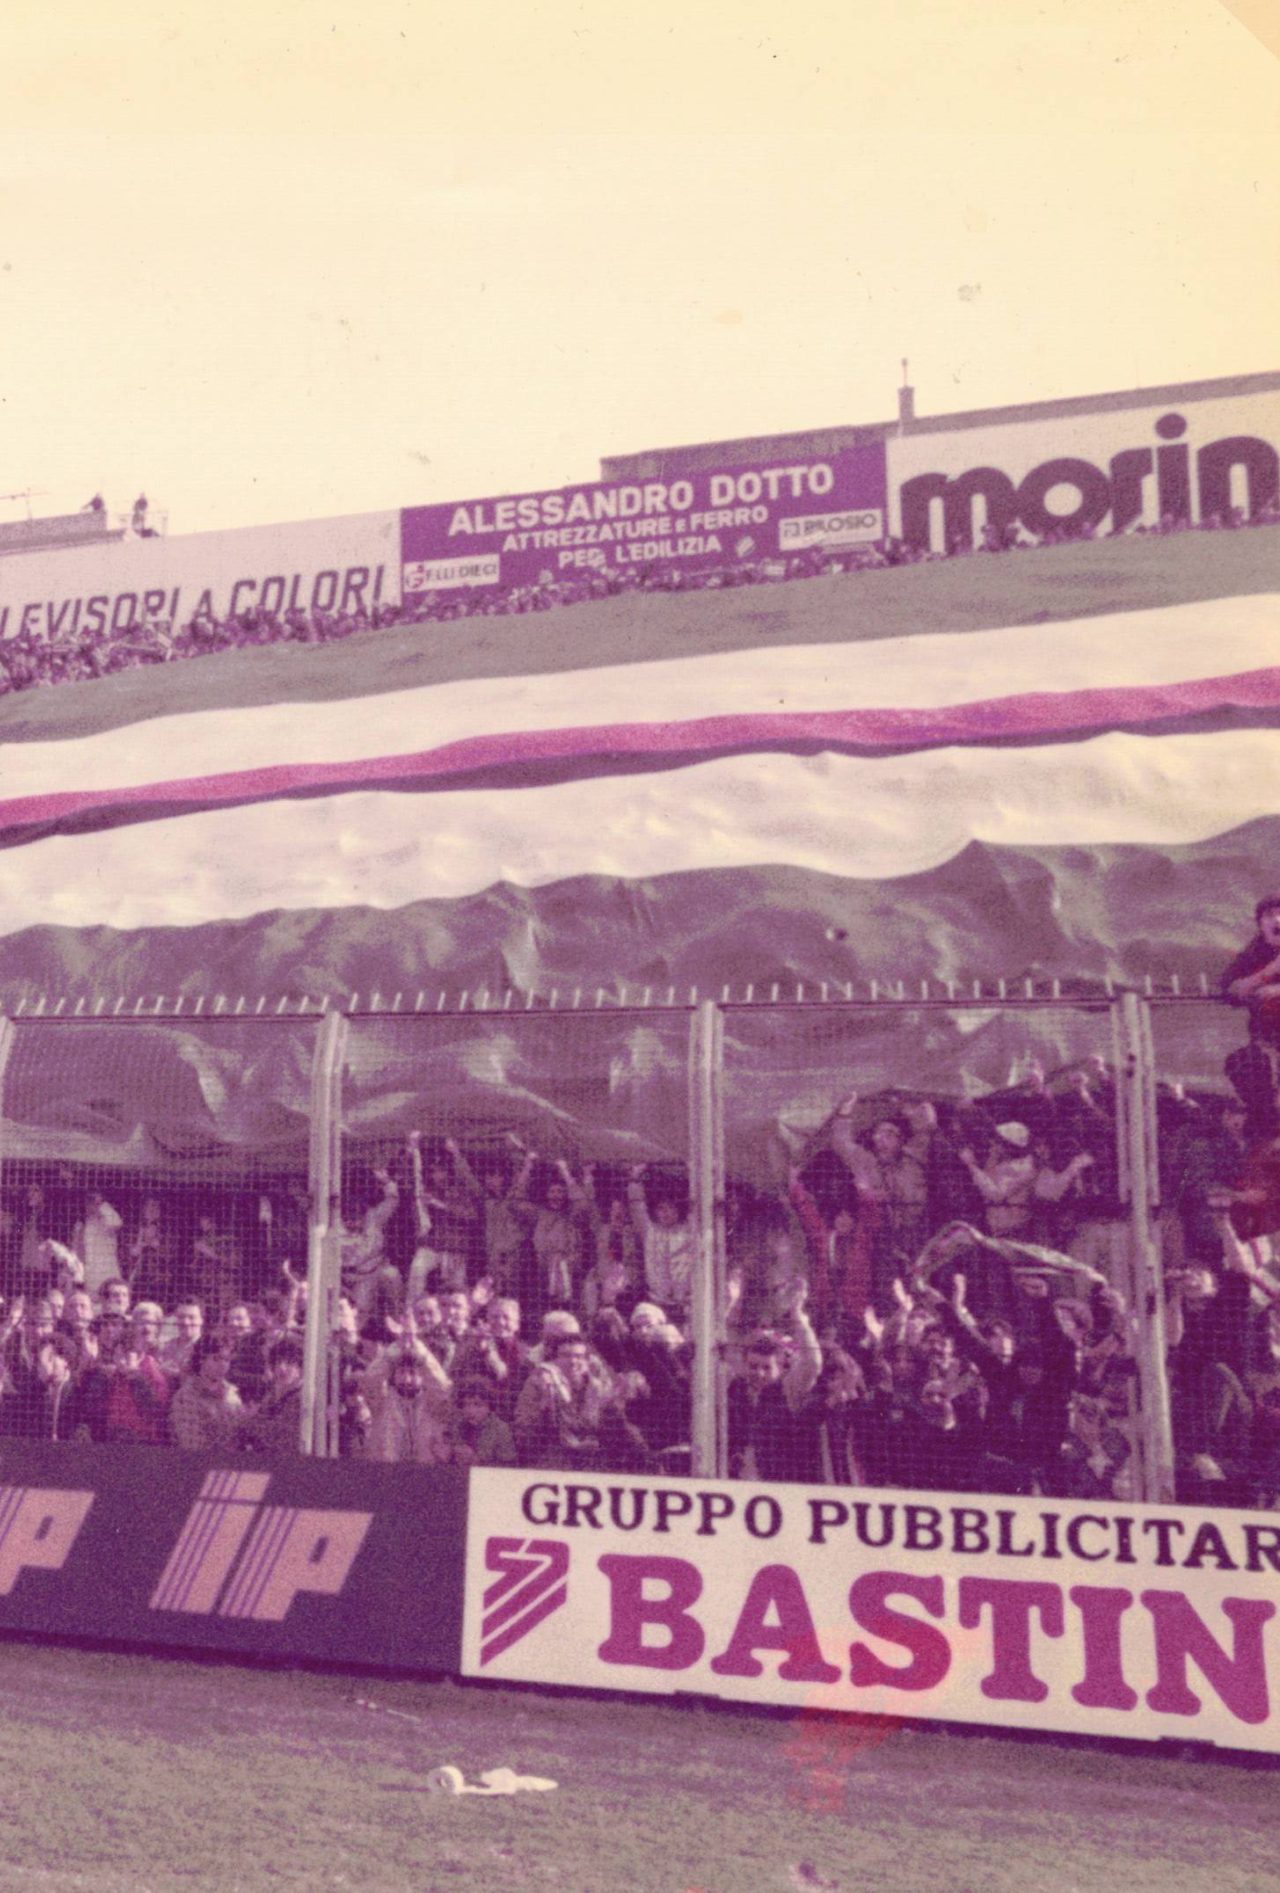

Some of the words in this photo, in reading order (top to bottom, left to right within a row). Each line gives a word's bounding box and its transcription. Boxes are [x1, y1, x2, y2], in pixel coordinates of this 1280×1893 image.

[448, 480, 695, 537] ALESSANDRO
[710, 462, 836, 508] DOTTO
[502, 516, 673, 553] ATTREZZATURE
[690, 505, 769, 532] FERRO
[229, 564, 384, 630] COLORI
[521, 1483, 783, 1539] GRUPPO
[597, 1554, 1276, 1725] BASTIN
